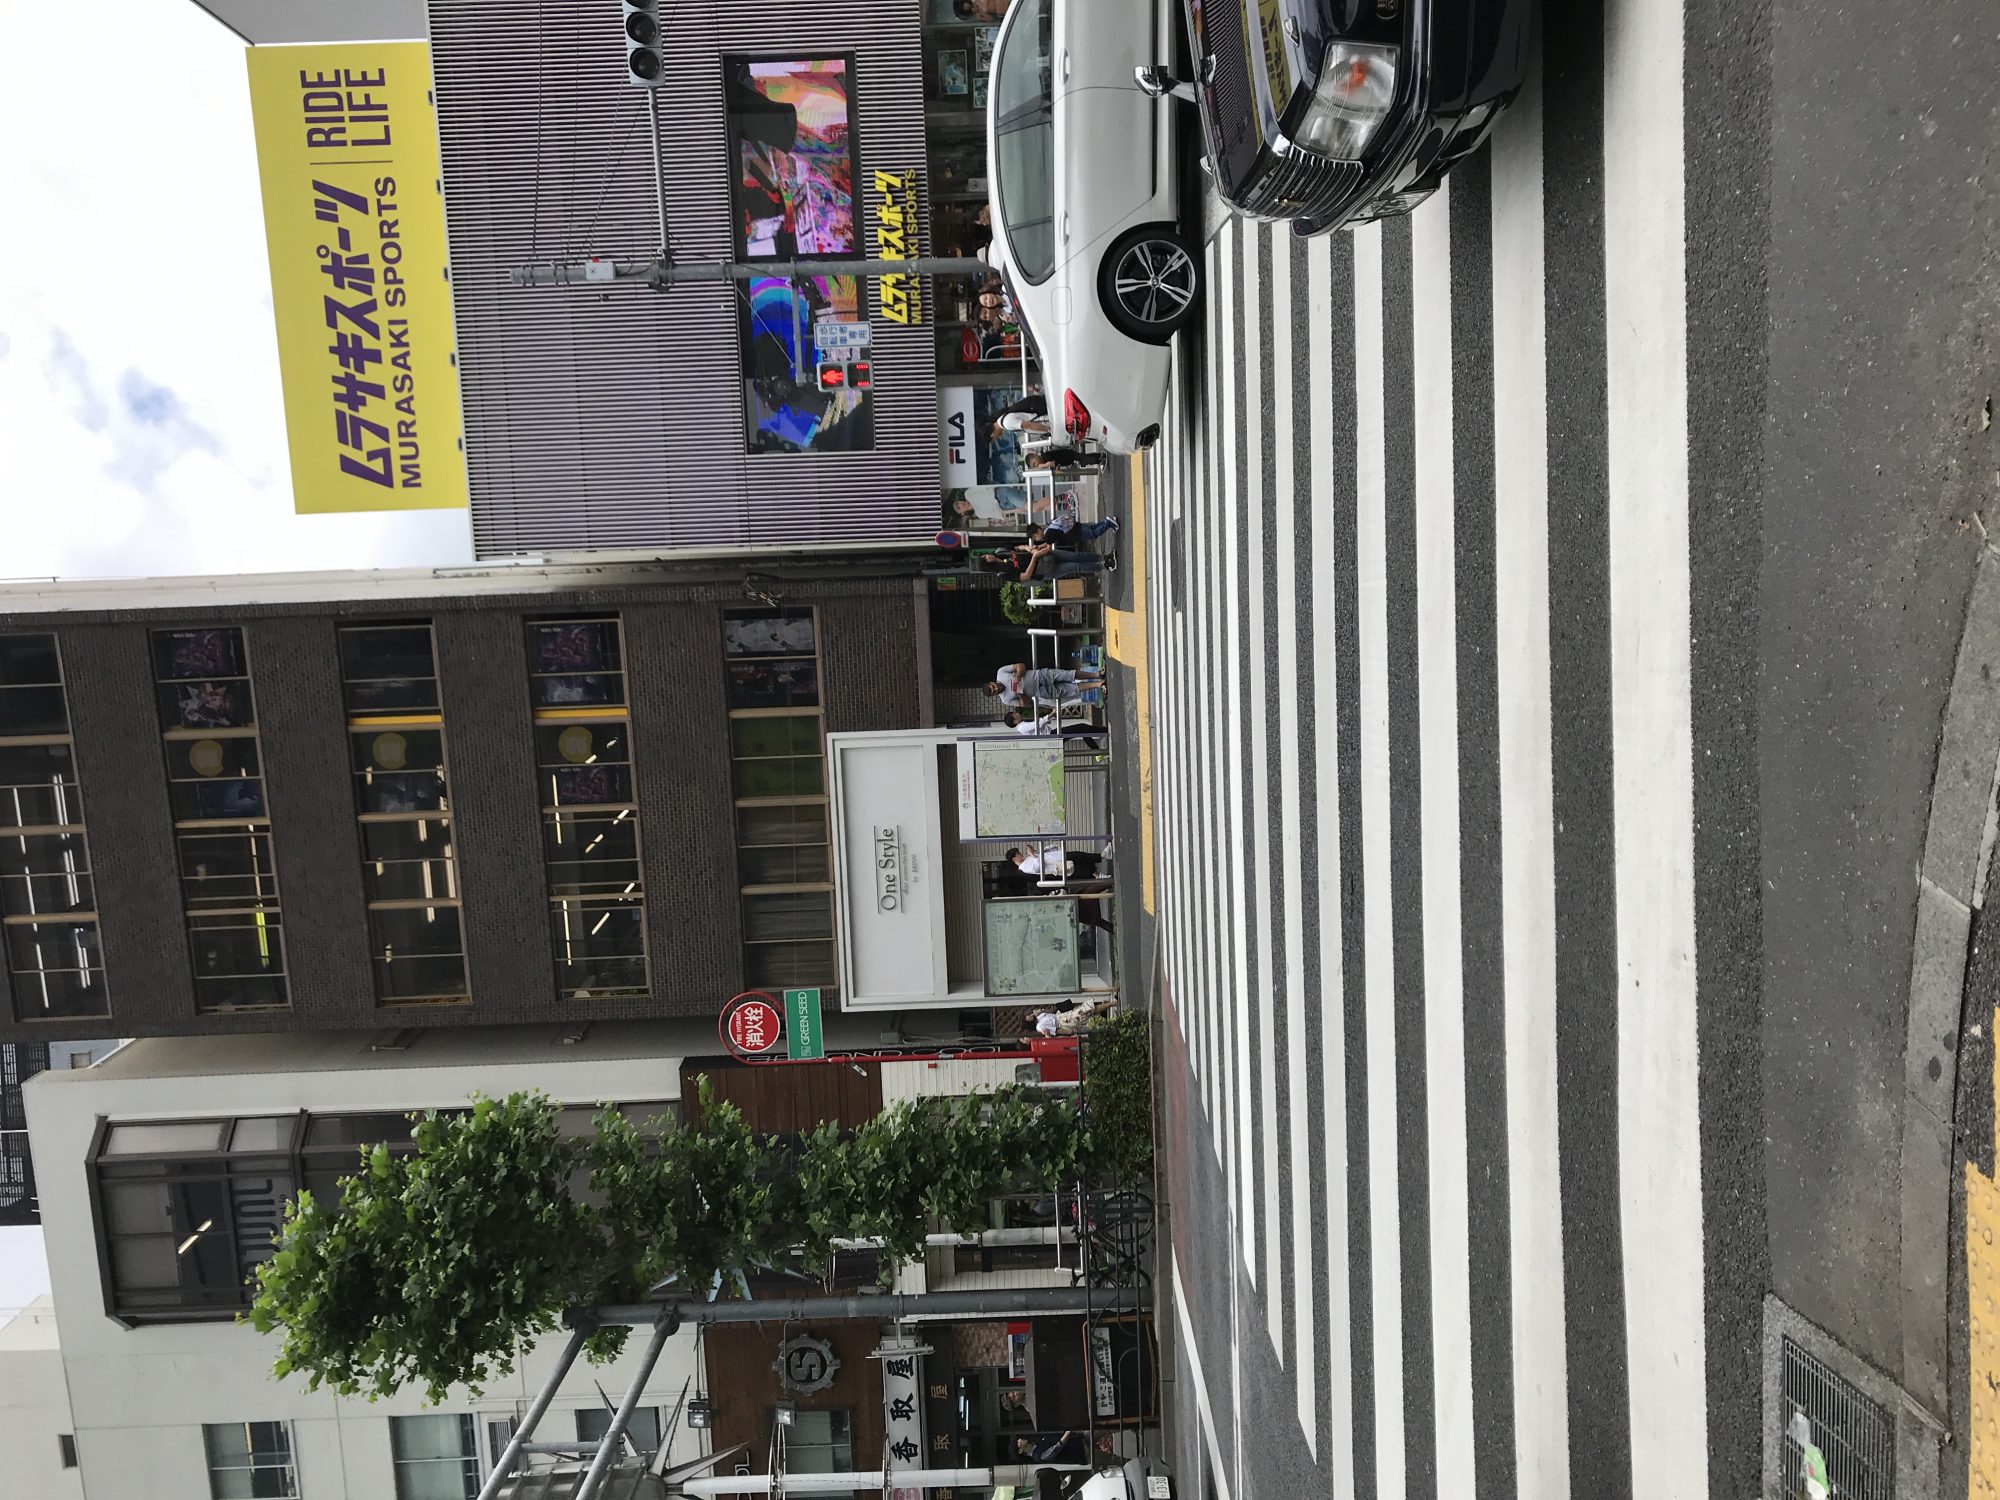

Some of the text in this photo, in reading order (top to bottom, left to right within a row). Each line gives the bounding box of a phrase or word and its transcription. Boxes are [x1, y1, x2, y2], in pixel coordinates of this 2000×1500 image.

[299, 69, 347, 148] RIDE
[344, 67, 392, 146] LIFE
[905, 168, 919, 234] SPORTS
[312, 179, 394, 489] ムラサキスポーツ
[374, 176, 421, 489] MURASAKI SPORTS
[947, 411, 966, 464] FILA
[876, 828, 898, 911] One Style
[743, 1006, 765, 1047] 消火栓
[797, 991, 810, 1045] GREEN SEED
[790, 1352, 822, 1381] S
[886, 1355, 918, 1463] 香取屋
[930, 1383, 952, 1500] 香取屋
